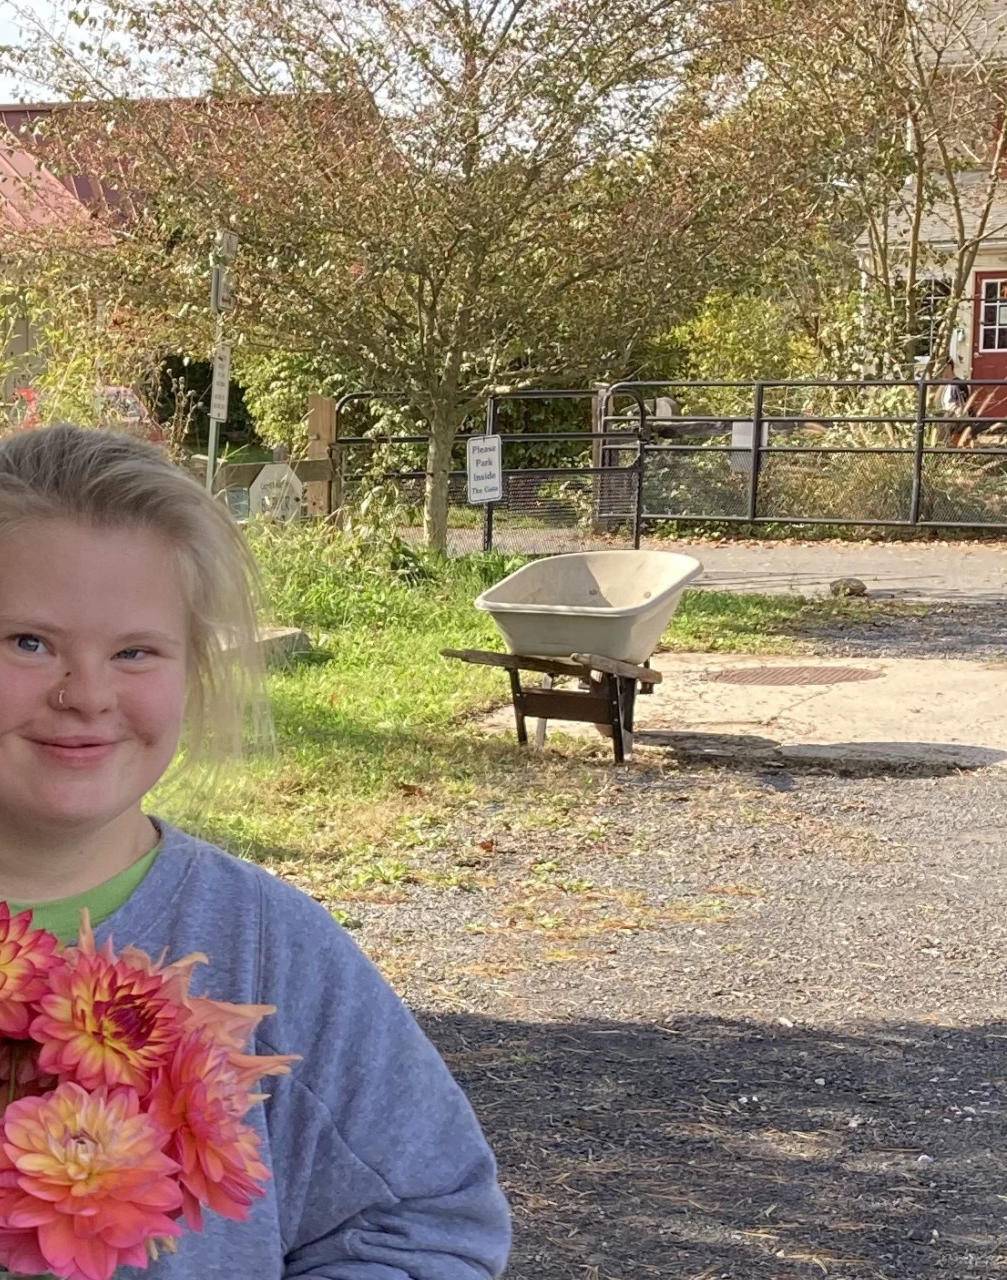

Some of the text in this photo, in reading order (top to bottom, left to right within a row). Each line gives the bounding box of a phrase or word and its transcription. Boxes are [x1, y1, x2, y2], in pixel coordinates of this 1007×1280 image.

[472, 446, 496, 454] Please
[476, 458, 493, 467] Park
[473, 471, 496, 481] Inside
